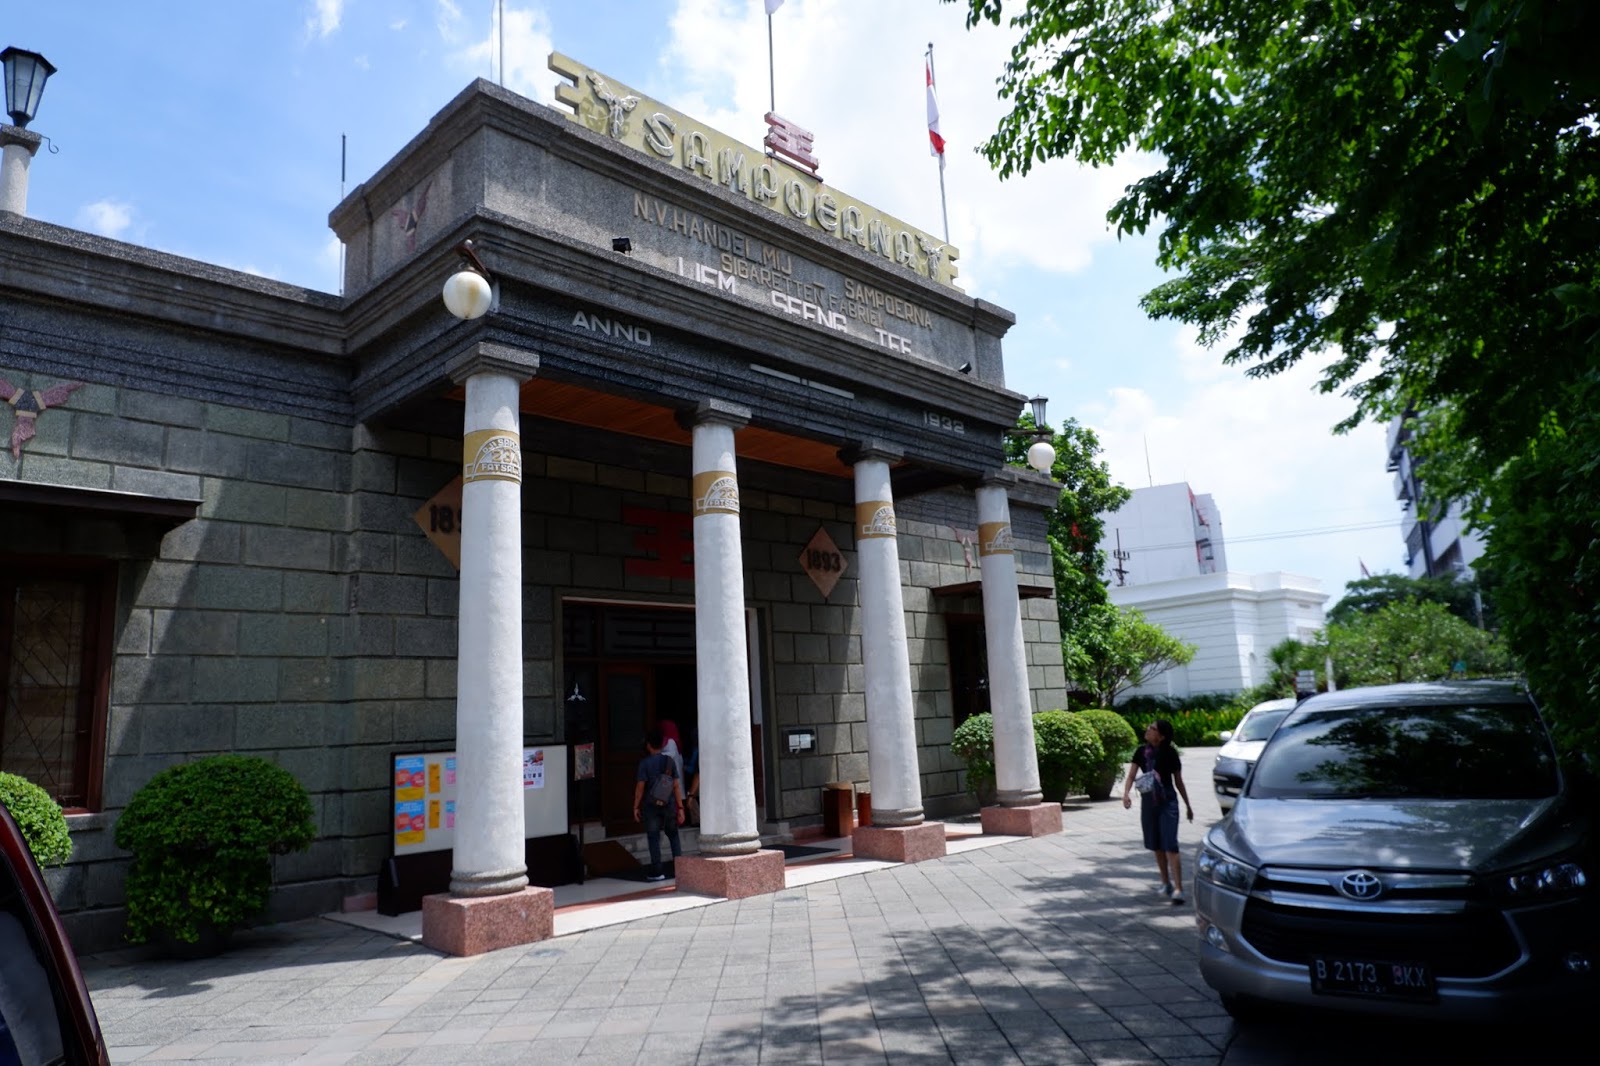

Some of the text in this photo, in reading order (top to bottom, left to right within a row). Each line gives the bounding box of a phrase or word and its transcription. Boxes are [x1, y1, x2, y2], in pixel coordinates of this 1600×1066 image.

[642, 112, 917, 269] SAMPOERNA
[720, 253, 824, 306] SIGARETTEN
[844, 277, 932, 331] SAMPOERNA
[572, 310, 652, 346] ANNO
[429, 504, 462, 533] 18
[806, 548, 841, 573] 1893
[1316, 959, 1327, 979] B
[1333, 961, 1378, 983] 2173
[1391, 964, 1426, 988] BKX
